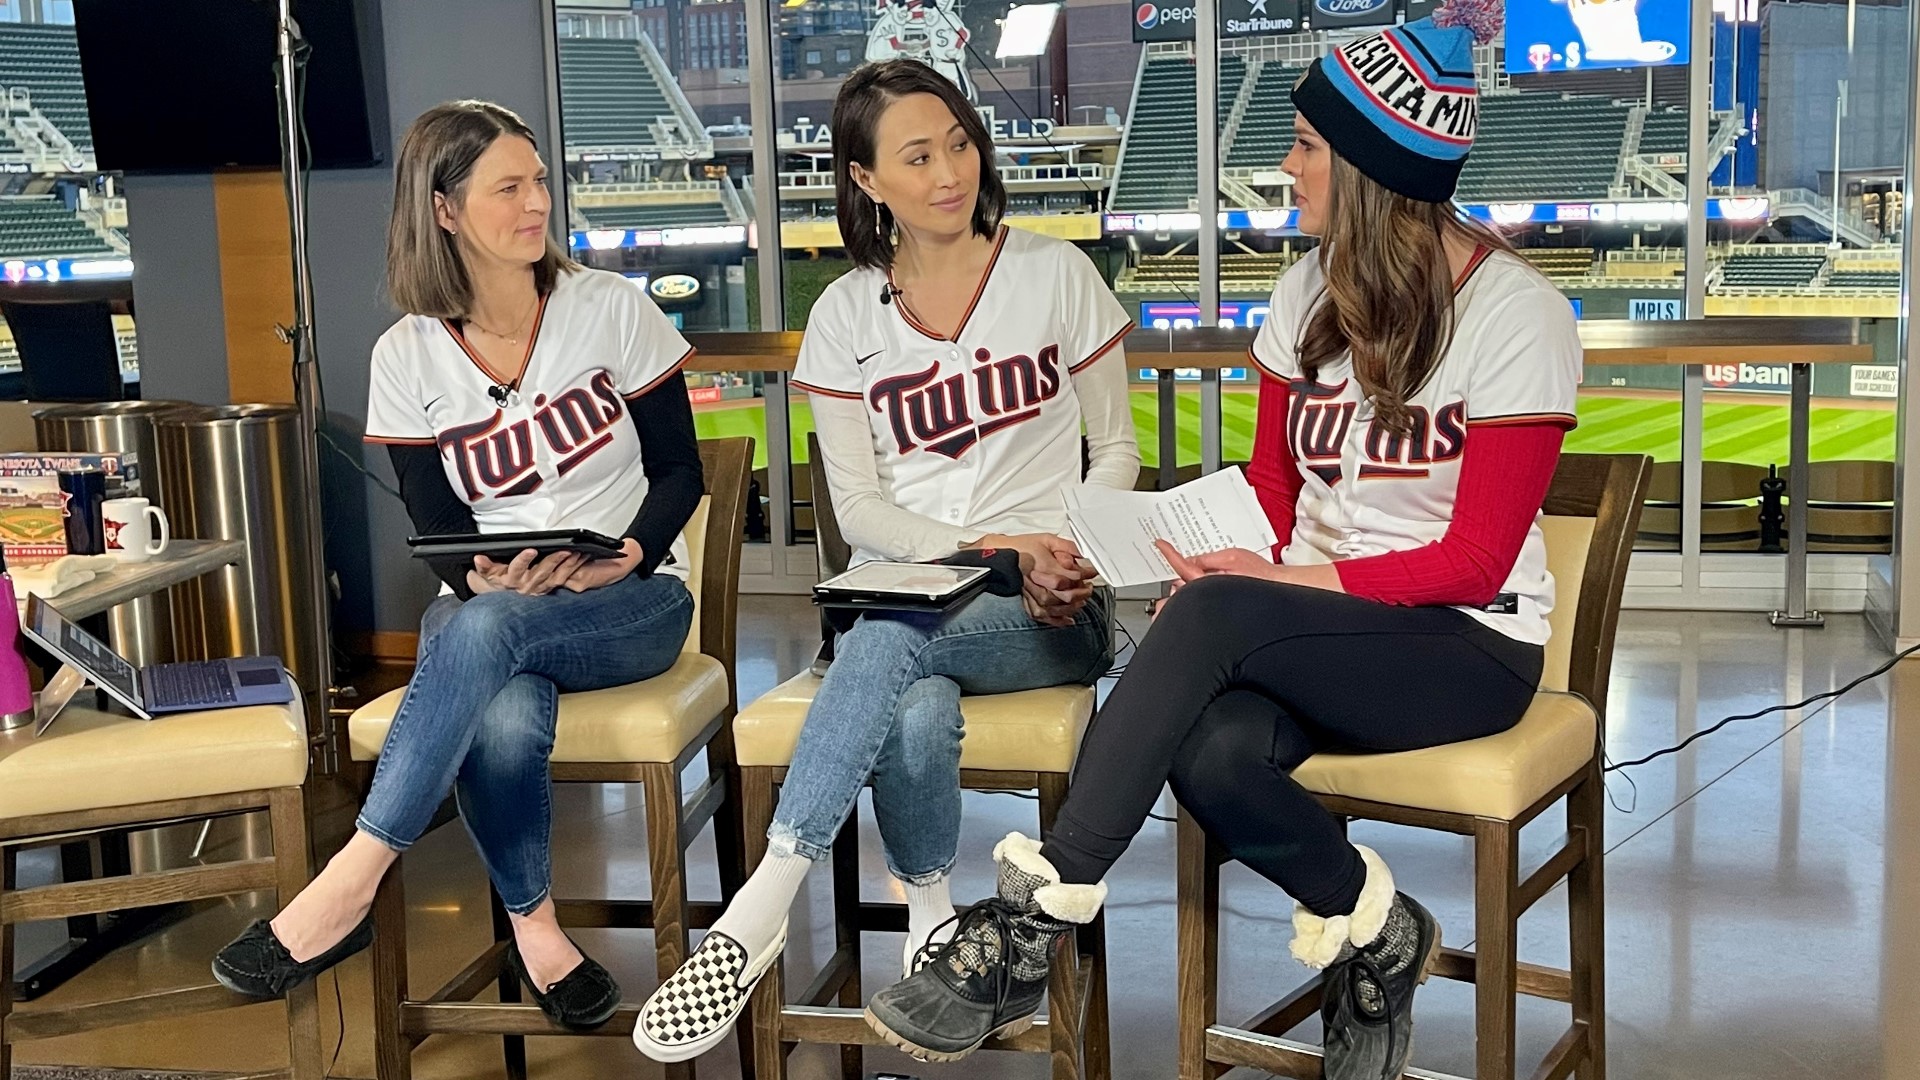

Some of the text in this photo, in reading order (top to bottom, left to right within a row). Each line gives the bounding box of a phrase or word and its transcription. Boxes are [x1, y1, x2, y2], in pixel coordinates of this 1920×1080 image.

[1226, 17, 1293, 33] StarTribune
[794, 118, 1054, 143] TA ELD
[1636, 303, 1674, 320] MPLS
[870, 344, 1060, 455] Twins
[437, 370, 623, 501] Twins
